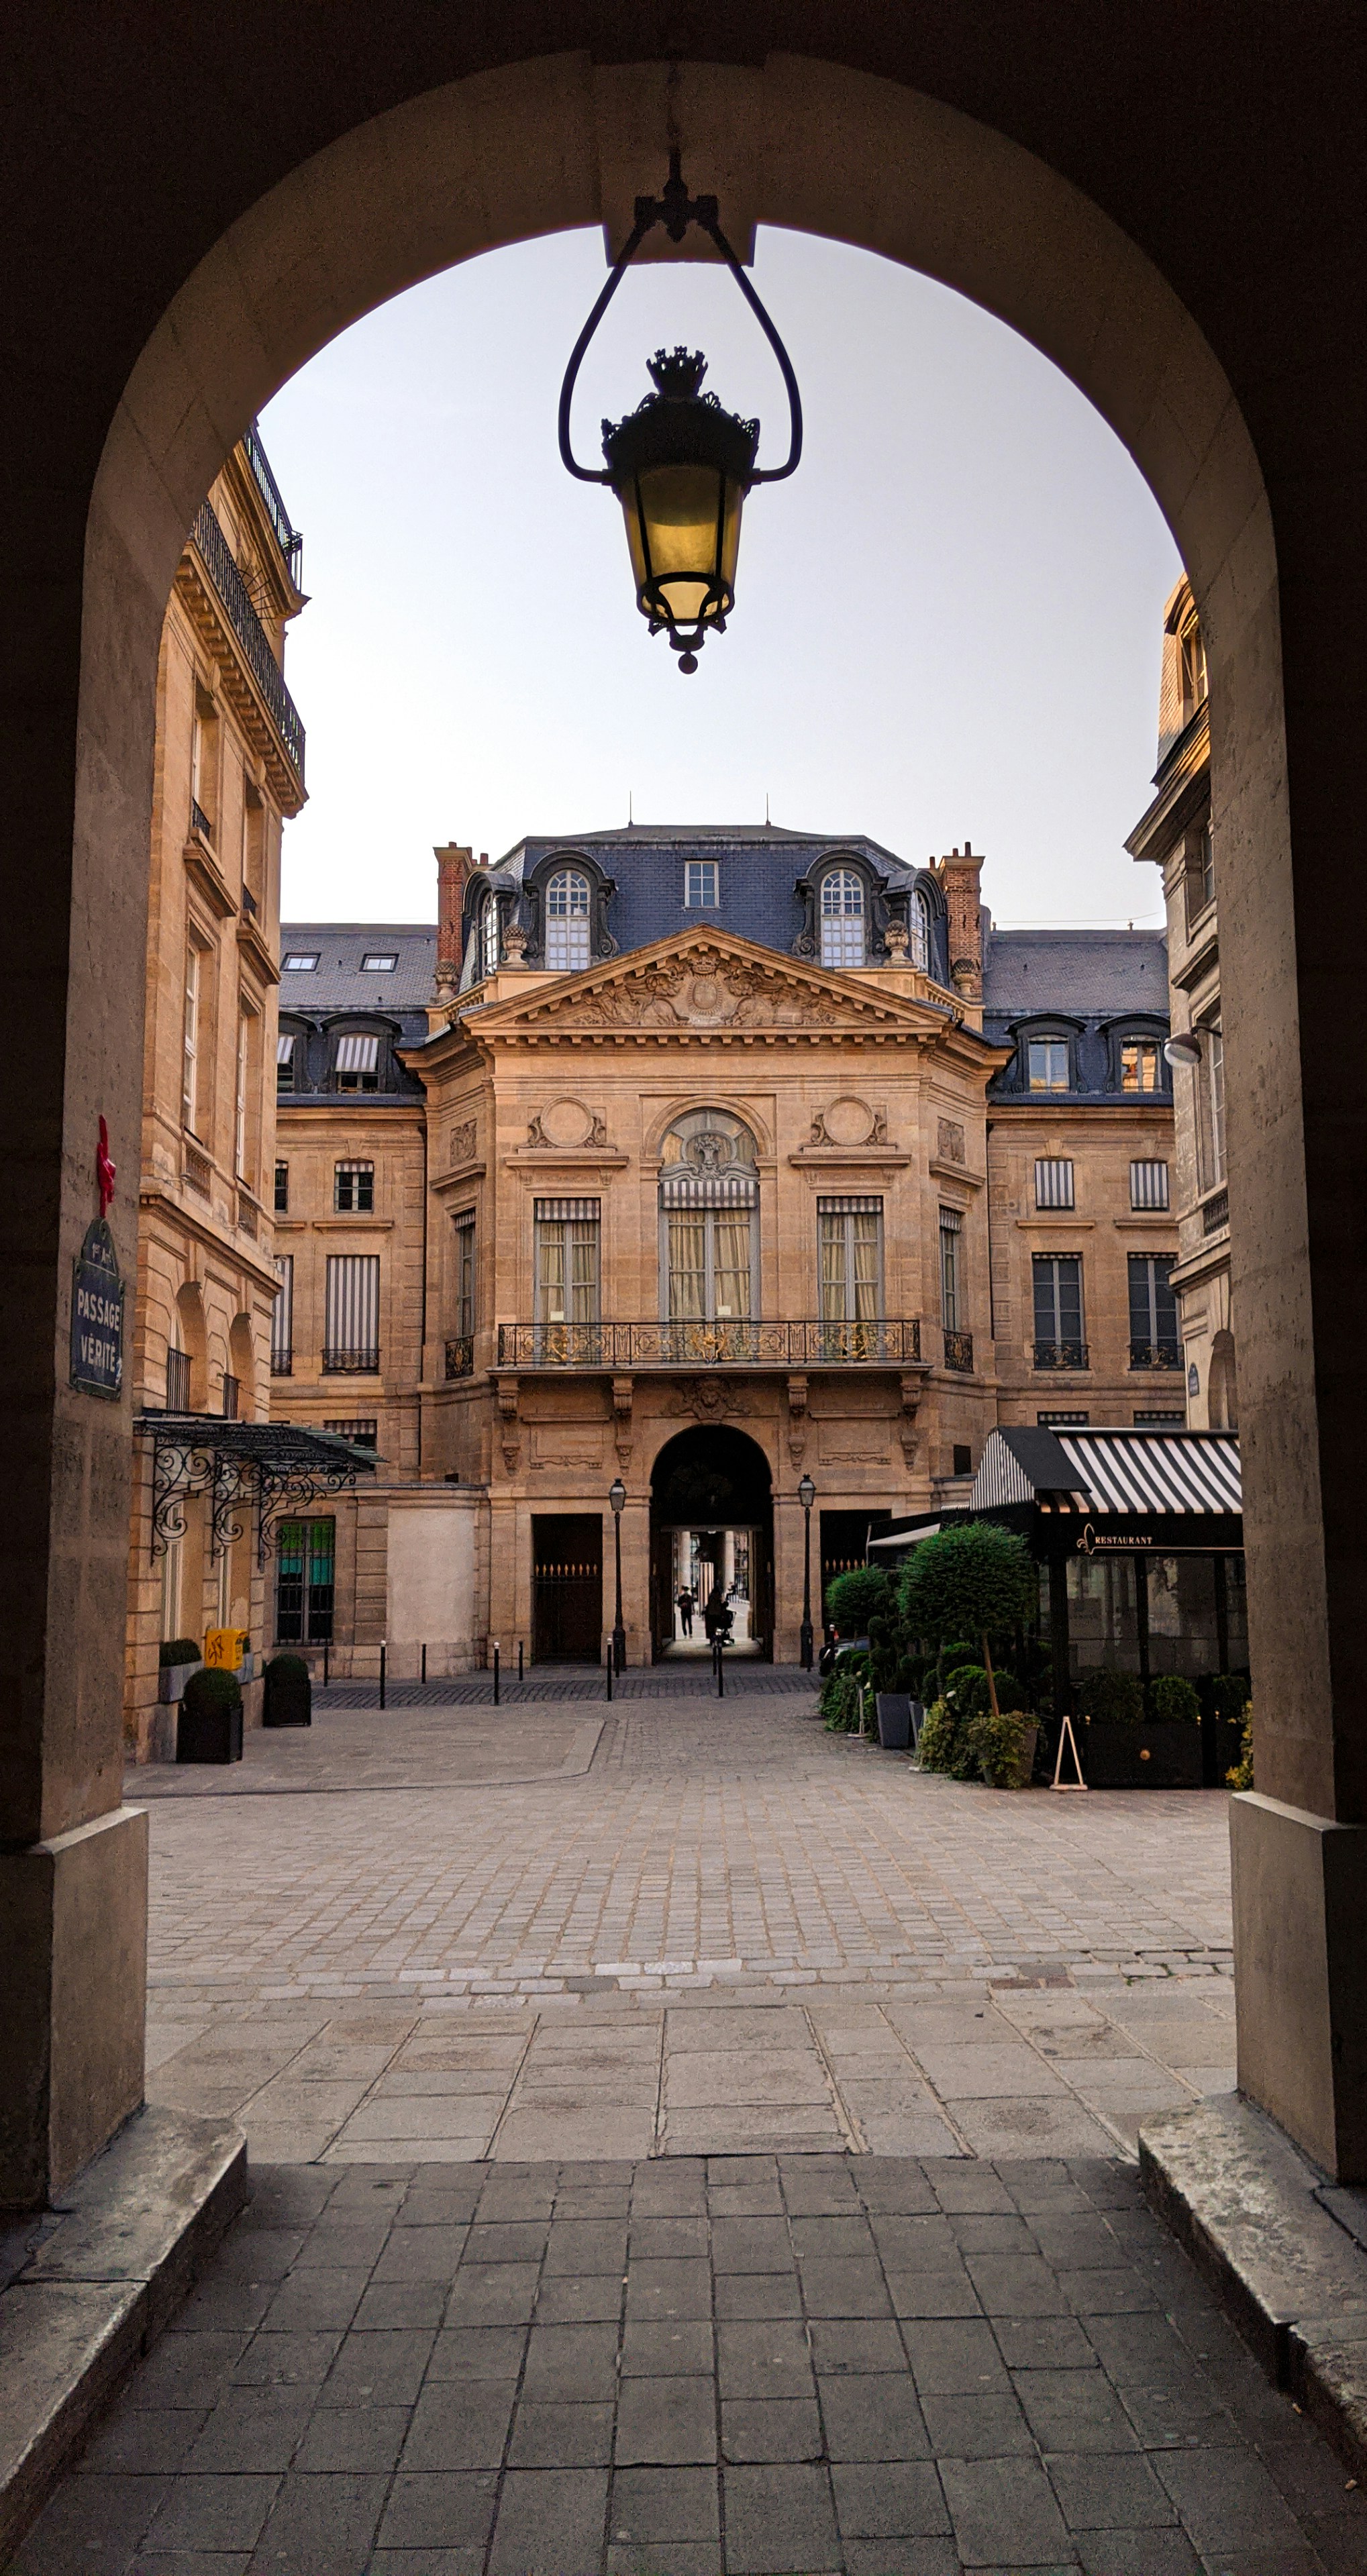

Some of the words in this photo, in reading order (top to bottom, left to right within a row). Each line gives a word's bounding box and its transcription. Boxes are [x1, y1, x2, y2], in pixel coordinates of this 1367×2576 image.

[77, 1288, 120, 1332] PASSAGE
[81, 1333, 115, 1373] VÉRITÉ
[1095, 1536, 1152, 1545] RESTAURANT
